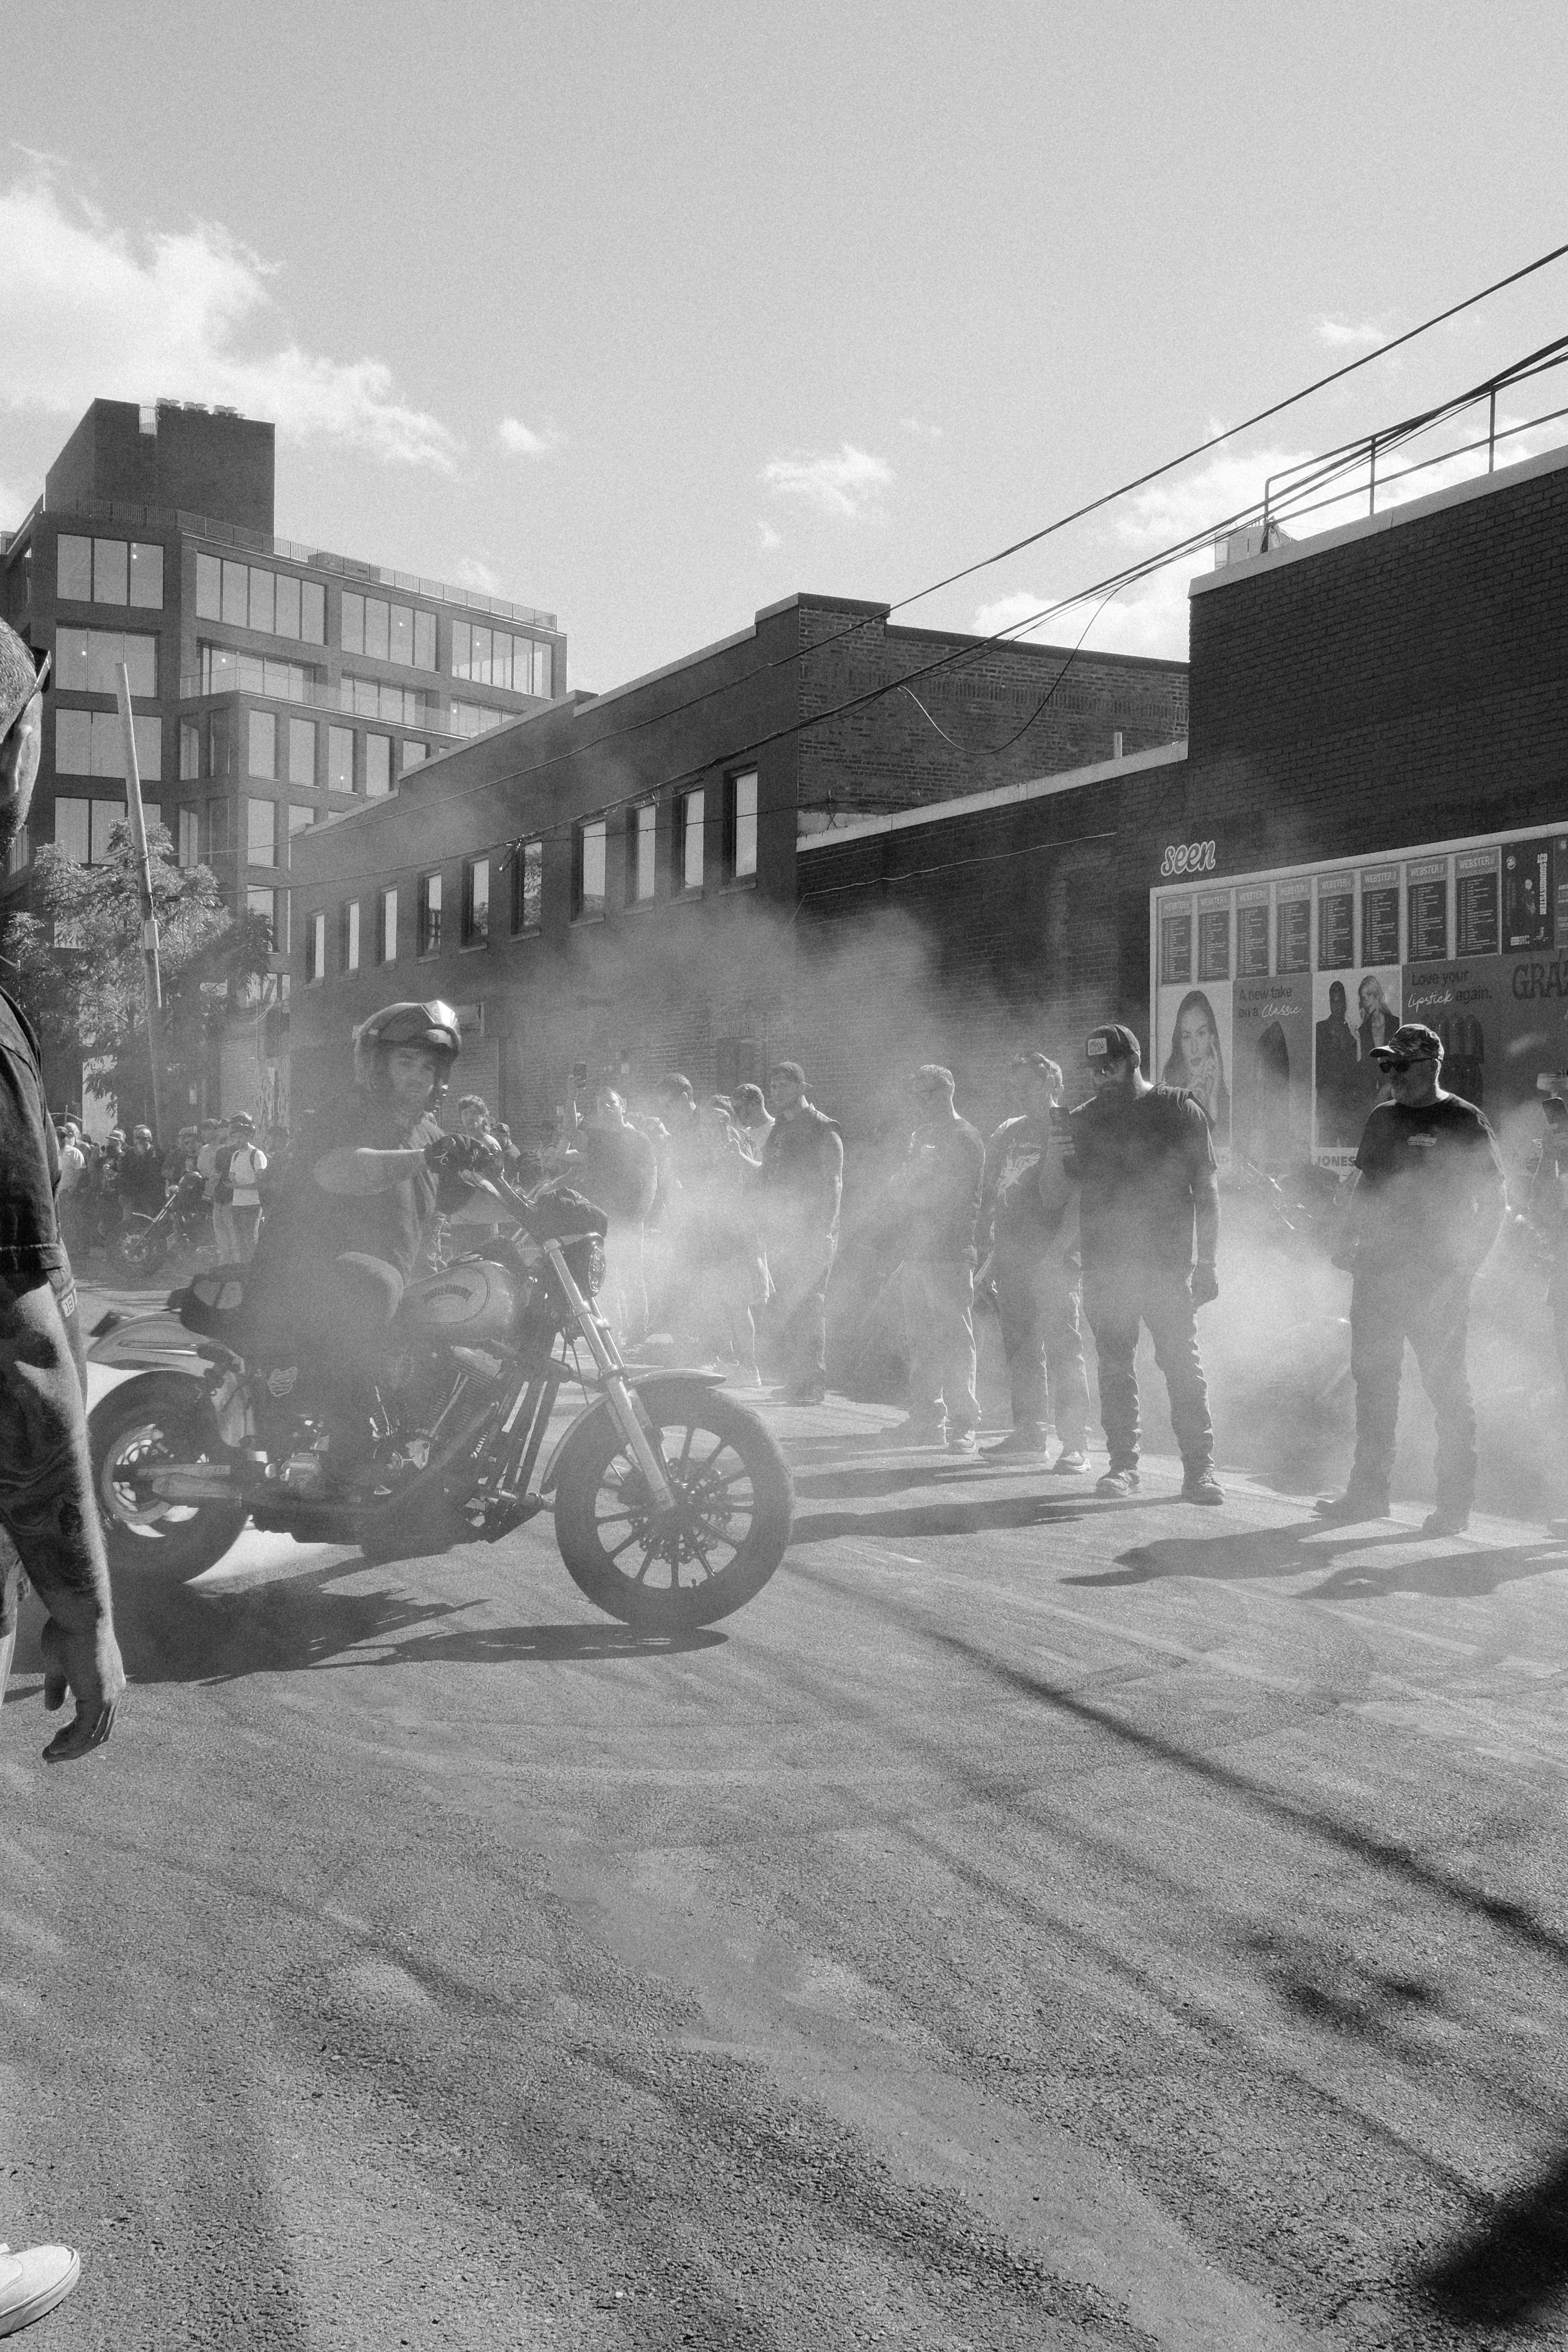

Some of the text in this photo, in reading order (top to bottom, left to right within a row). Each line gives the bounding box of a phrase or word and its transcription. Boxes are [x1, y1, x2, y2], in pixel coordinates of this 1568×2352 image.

[1161, 840, 1216, 876] seen
[1459, 856, 1490, 869] WEBSTER
[1364, 871, 1392, 883] WEBSTER
[1410, 864, 1439, 877] WEBSTER
[1321, 878, 1347, 890] WEBSTER
[1412, 970, 1469, 988] Love your
[1239, 986, 1292, 1001] A new take
[1455, 985, 1492, 1005] again.
[1238, 1008, 1250, 1018] on
[1253, 1007, 1259, 1017] a
